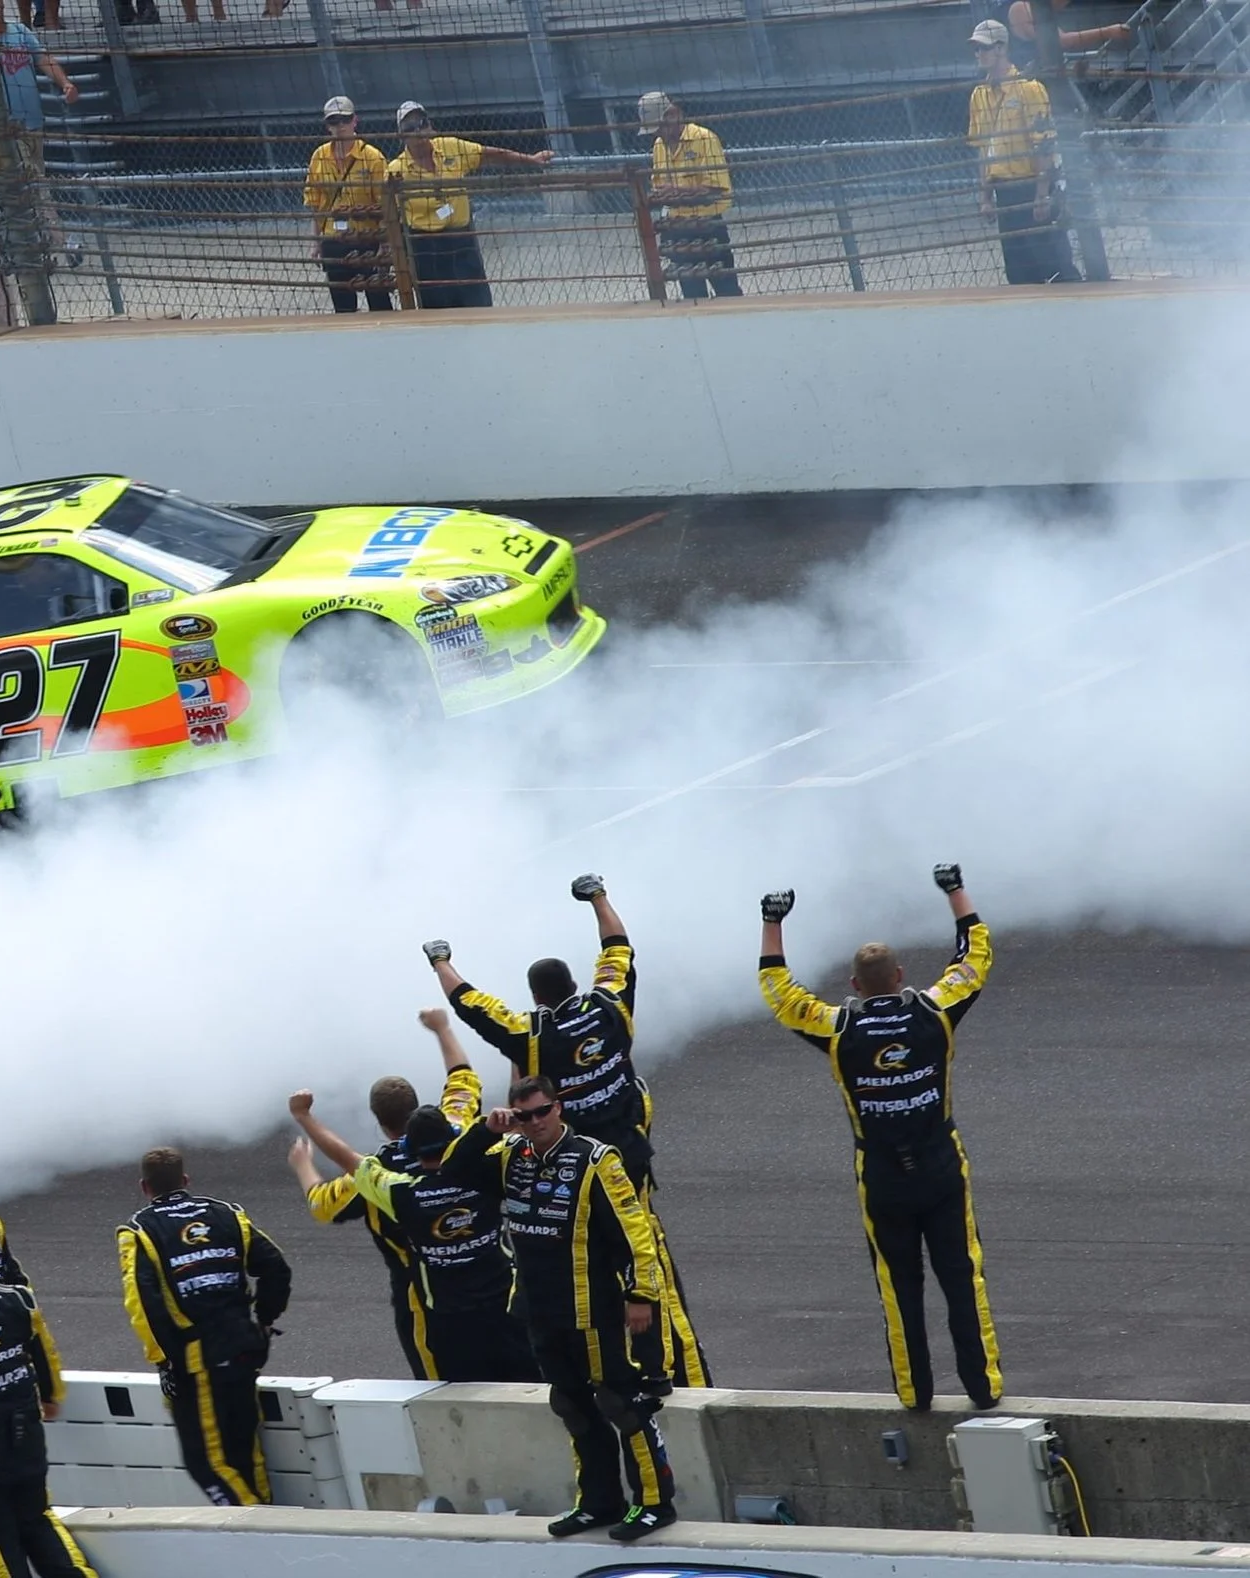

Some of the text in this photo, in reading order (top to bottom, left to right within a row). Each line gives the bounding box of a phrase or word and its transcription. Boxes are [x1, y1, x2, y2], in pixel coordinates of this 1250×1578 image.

[349, 508, 456, 578] NIBCO
[185, 705, 228, 722] Holley
[190, 722, 228, 747] 3M
[560, 1051, 624, 1088] MENARDS
[856, 1065, 934, 1087] MENARDS
[860, 1088, 940, 1113] PITTSBURGH
[421, 1229, 499, 1257] MENARDS
[170, 1247, 237, 1268] MENARDS
